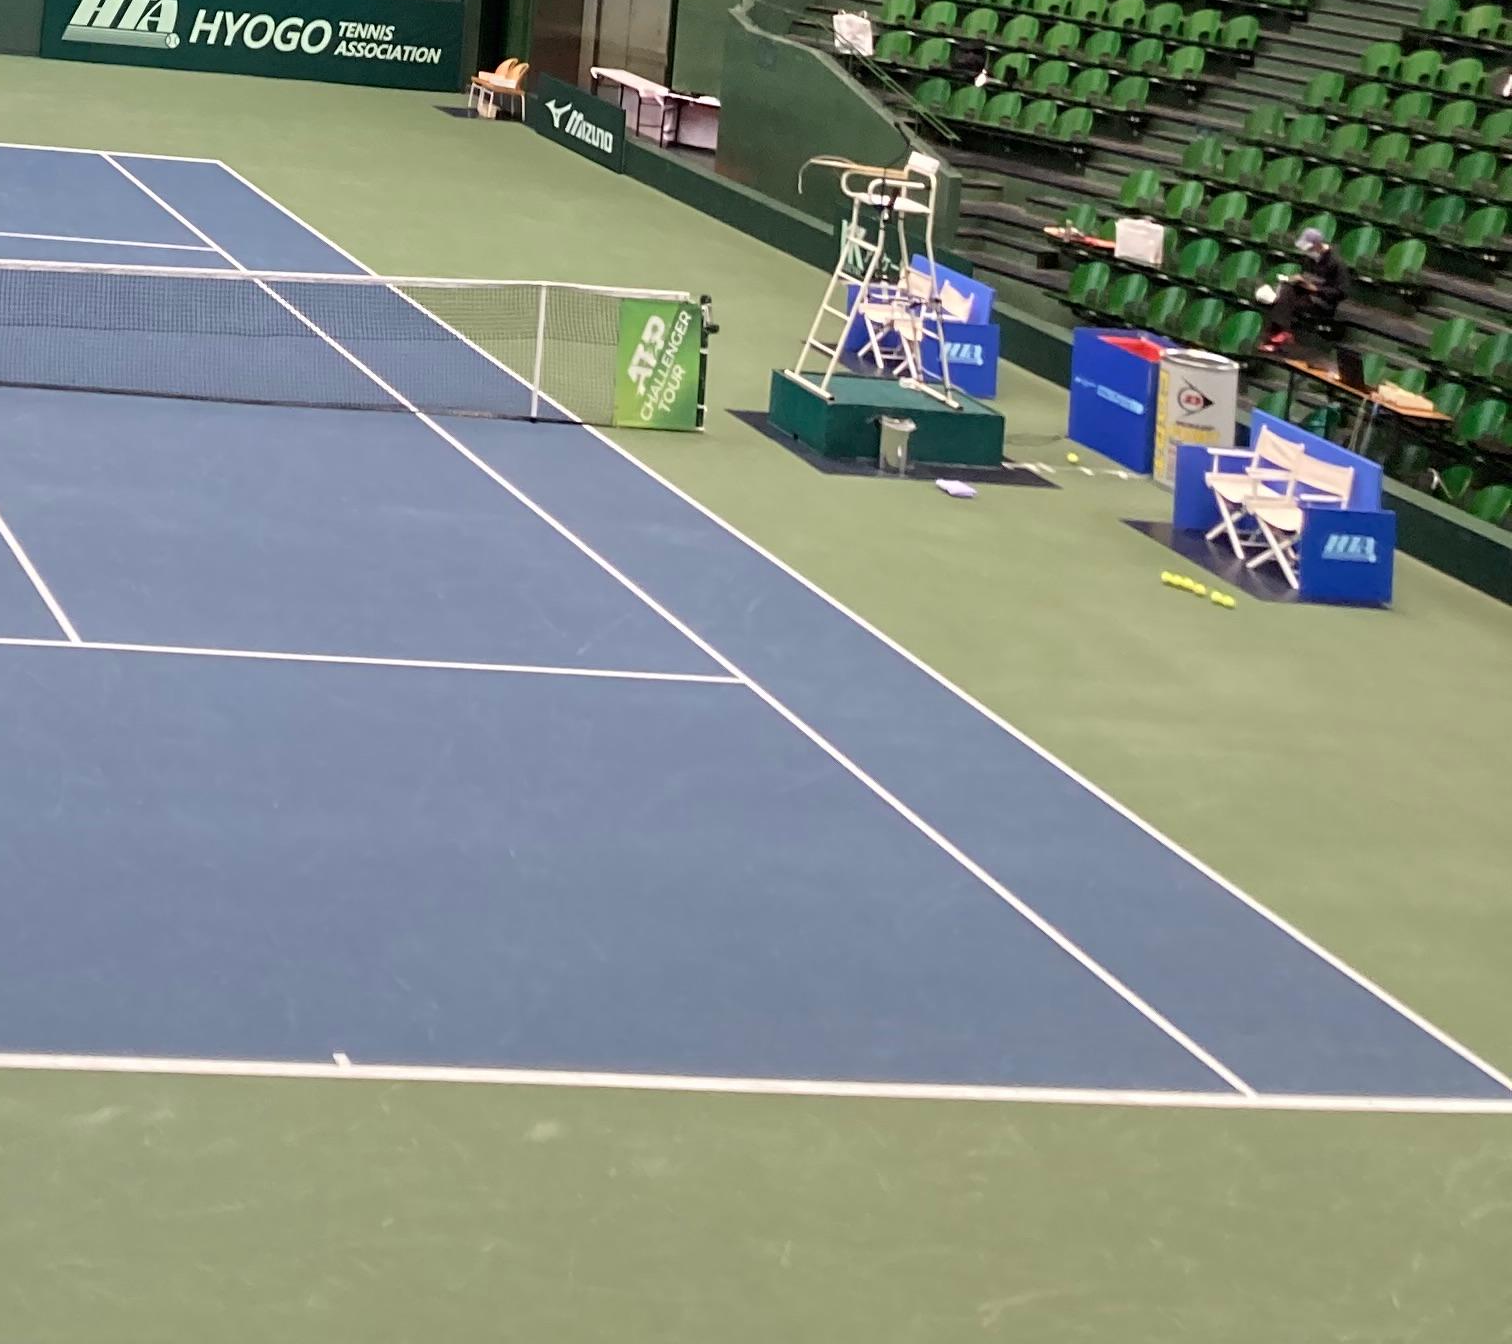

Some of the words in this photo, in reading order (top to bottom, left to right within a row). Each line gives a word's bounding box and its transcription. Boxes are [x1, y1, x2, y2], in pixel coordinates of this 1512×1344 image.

[189, 9, 332, 54] HYOGO
[338, 21, 395, 41] TENNIS
[333, 42, 441, 65] ASSOCIATION
[628, 315, 665, 396] ATP
[640, 310, 692, 421] CHALLENGER
[658, 364, 686, 412] TOUR
